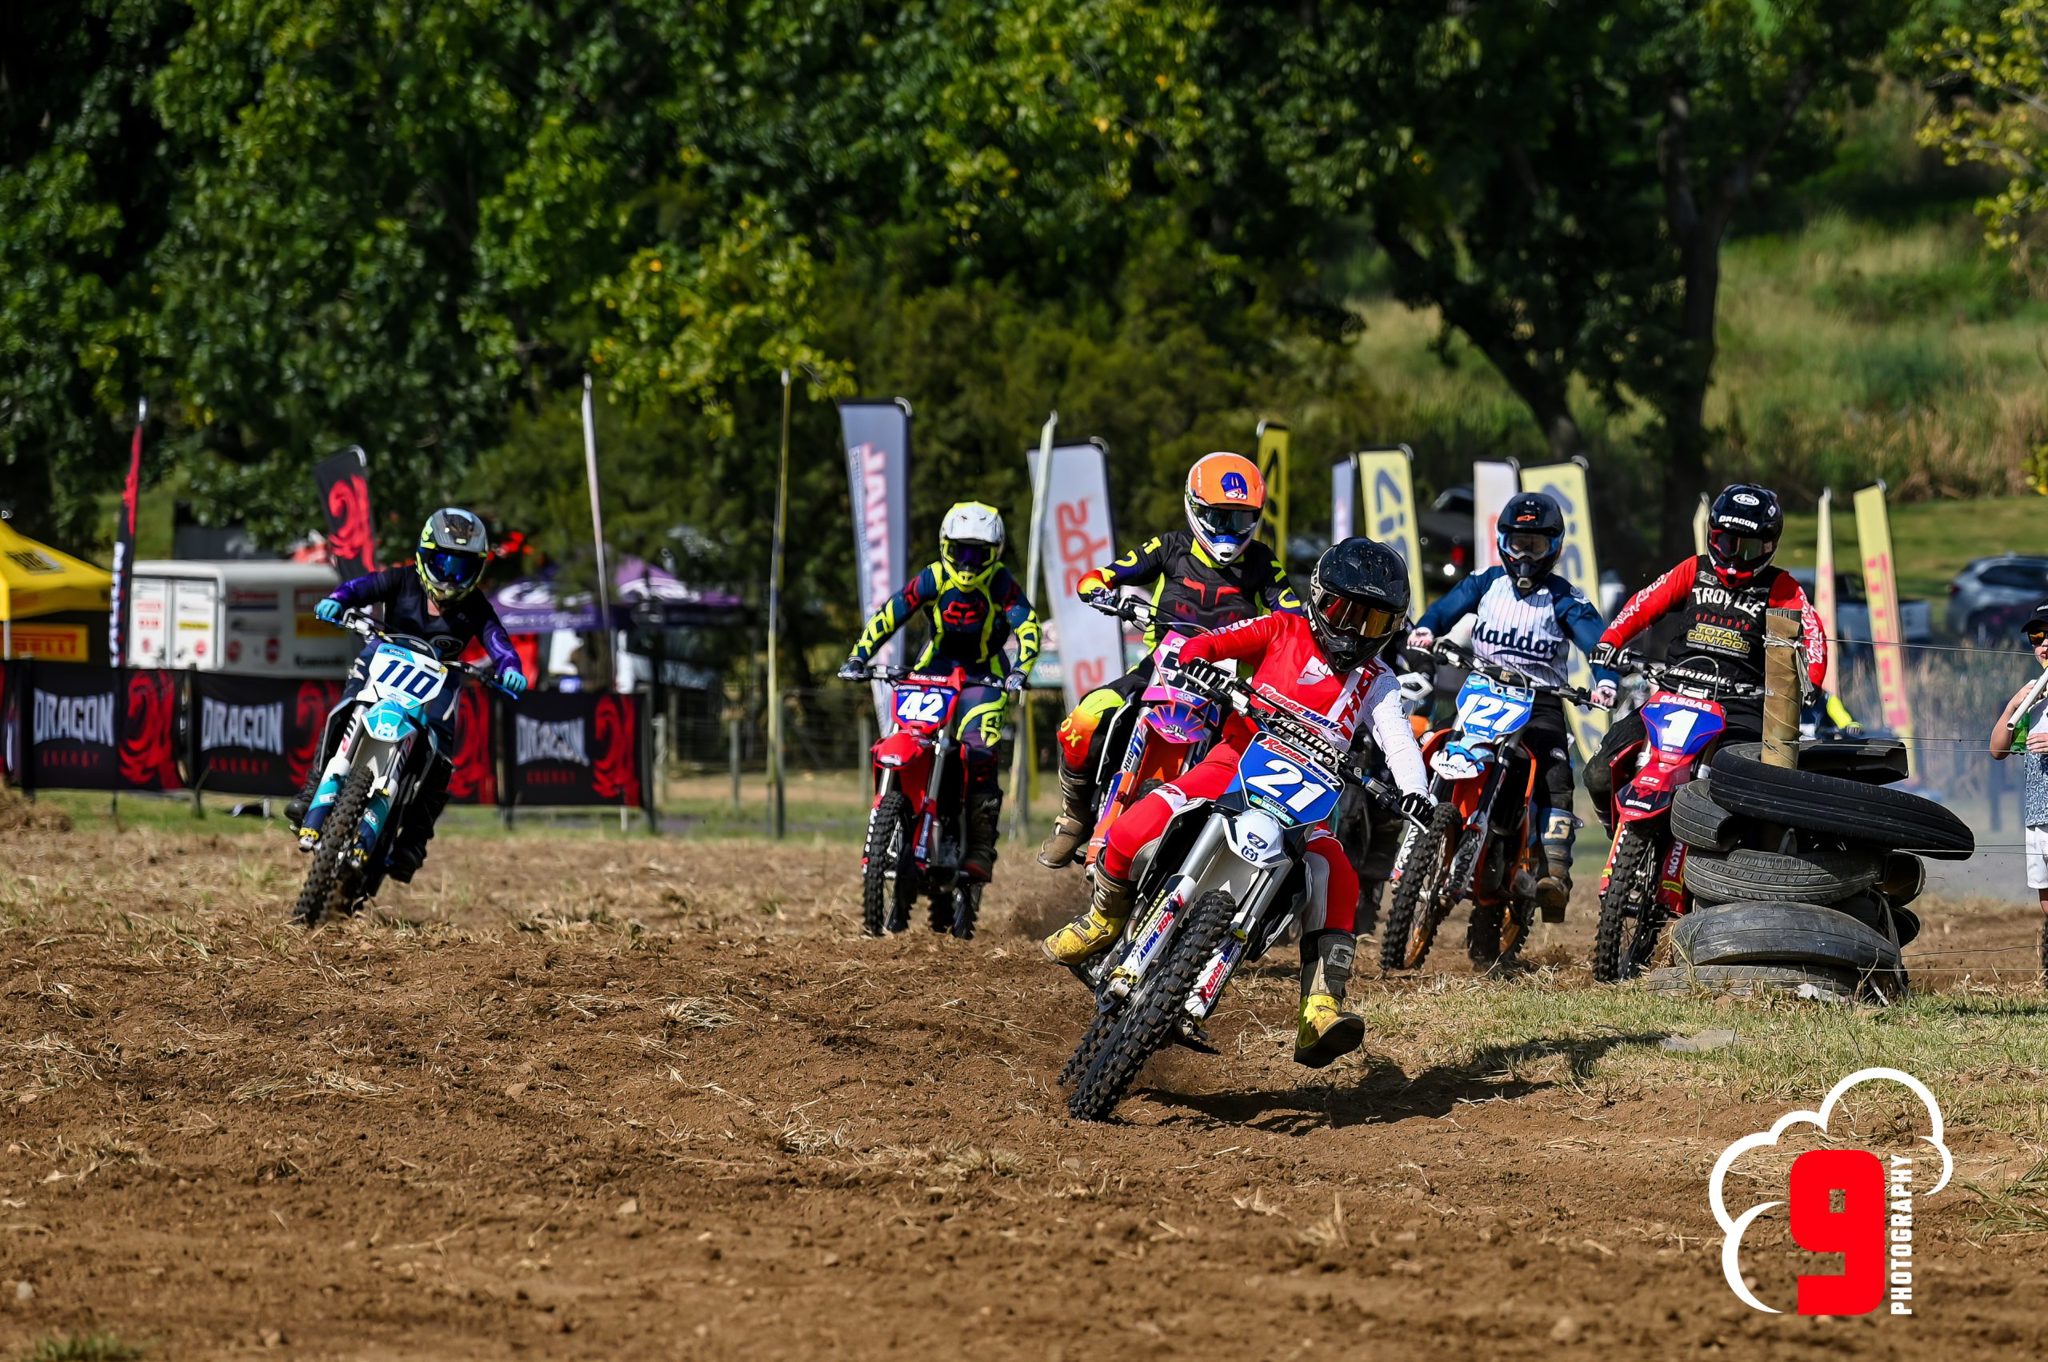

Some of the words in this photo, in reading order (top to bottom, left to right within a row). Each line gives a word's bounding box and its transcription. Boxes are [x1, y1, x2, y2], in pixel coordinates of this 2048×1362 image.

[1718, 515, 1758, 530] DRAGON
[1692, 587, 1733, 611] TROY
[1734, 592, 1767, 618] LEE
[1687, 632, 1749, 651] CONTROL
[1697, 625, 1741, 641] TOTAL
[376, 660, 440, 700] 110
[34, 688, 115, 746] DRAGON
[897, 691, 944, 723] 42
[1454, 694, 1527, 733] 127
[1659, 695, 1713, 711] GASGAS
[202, 697, 283, 755] DRAGON
[1661, 709, 1699, 747] 1
[1258, 737, 1341, 791] RIDGEWAY
[1245, 759, 1327, 812] 21
[1667, 841, 1684, 877] MOTU
